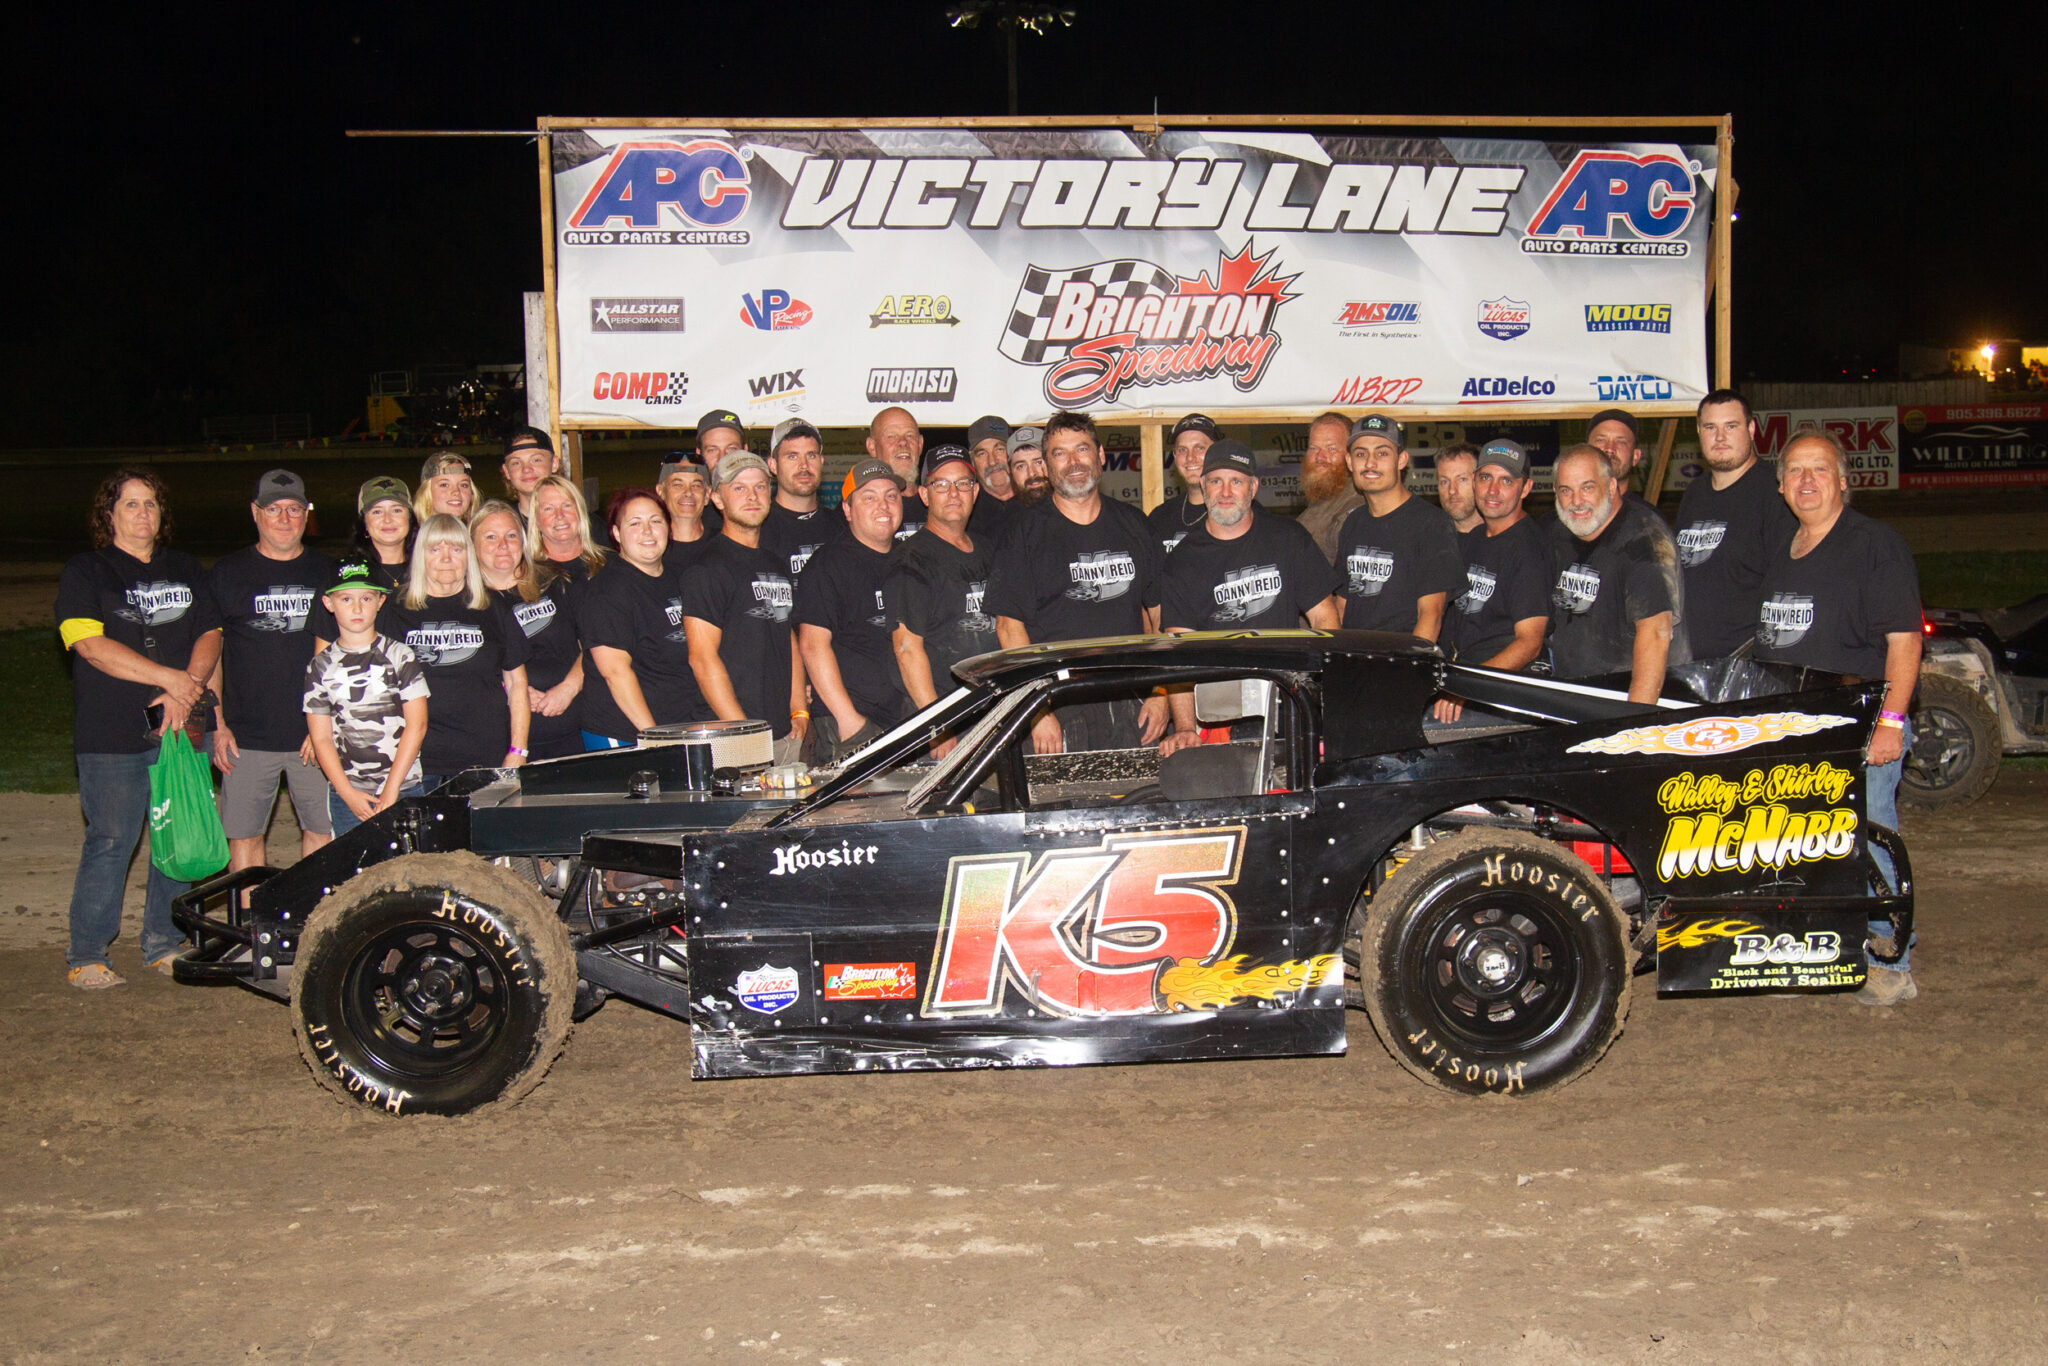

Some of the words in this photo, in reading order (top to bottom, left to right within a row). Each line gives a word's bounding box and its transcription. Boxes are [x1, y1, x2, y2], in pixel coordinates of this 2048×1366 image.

[568, 141, 751, 228] APC
[780, 156, 1246, 231] VICTORY
[1244, 158, 1527, 237] LANE
[1527, 151, 1695, 239] APC
[567, 231, 614, 244] AUTO
[619, 231, 672, 244] PARTS
[676, 231, 748, 244] CENTRES
[1524, 239, 1563, 252] AUTO
[1569, 241, 1618, 254] PARTS
[1621, 243, 1686, 255] CENTRES
[609, 304, 680, 314] ALLSTAR
[741, 288, 791, 331] VP
[875, 295, 951, 320] AERO
[1046, 280, 1274, 341] BRIGHTON
[1335, 301, 1421, 325] AMSOIL
[1484, 310, 1528, 322] LUCAS
[1587, 304, 1671, 322] MOOG
[610, 316, 680, 324] PERFORMANCE
[773, 309, 813, 325] Racing
[1380, 331, 1418, 339] Synthetics
[1493, 323, 1529, 331] PRODUCTS
[1591, 322, 1633, 331] CHASSIS
[1640, 322, 1668, 333] PARTS
[1048, 327, 1278, 402] Speedway
[593, 372, 668, 400] COMP
[748, 368, 805, 398] WIX
[867, 368, 956, 400] MOROSO
[1330, 376, 1423, 404] MBRP
[1462, 376, 1555, 397] ACDelco
[645, 395, 682, 405] CAMS
[1752, 412, 1896, 458] MRK
[1868, 456, 1893, 468] LTD.
[1071, 565, 1106, 581] DANNY
[1109, 562, 1135, 577] REID
[1373, 561, 1393, 577] REID
[164, 590, 193, 604] REID
[1215, 582, 1250, 604] DANNY
[1254, 575, 1281, 593] REID
[1475, 580, 1495, 597] REID
[256, 598, 296, 613] DANNY
[529, 602, 556, 618] REID
[1761, 607, 1787, 623] DANNY
[1789, 609, 1812, 624] REID
[406, 634, 450, 646] DANNY
[454, 632, 484, 645] REID
[1739, 768, 1765, 804] &
[1763, 761, 1855, 805] Shirley
[768, 839, 879, 876] Hoosier
[1480, 853, 1599, 923] Hoosier
[921, 825, 1248, 1018] K5
[1729, 931, 1841, 966] B&B
[841, 965, 897, 981] BRIGHTON
[1763, 965, 1788, 975] and
[747, 978, 793, 994] LUCAS
[838, 977, 900, 995] Speedway
[1710, 976, 1791, 989] Driveway
[1797, 973, 1866, 987] Sealing
[743, 995, 756, 1003] OIL
[757, 992, 795, 1002] PRODUCTS
